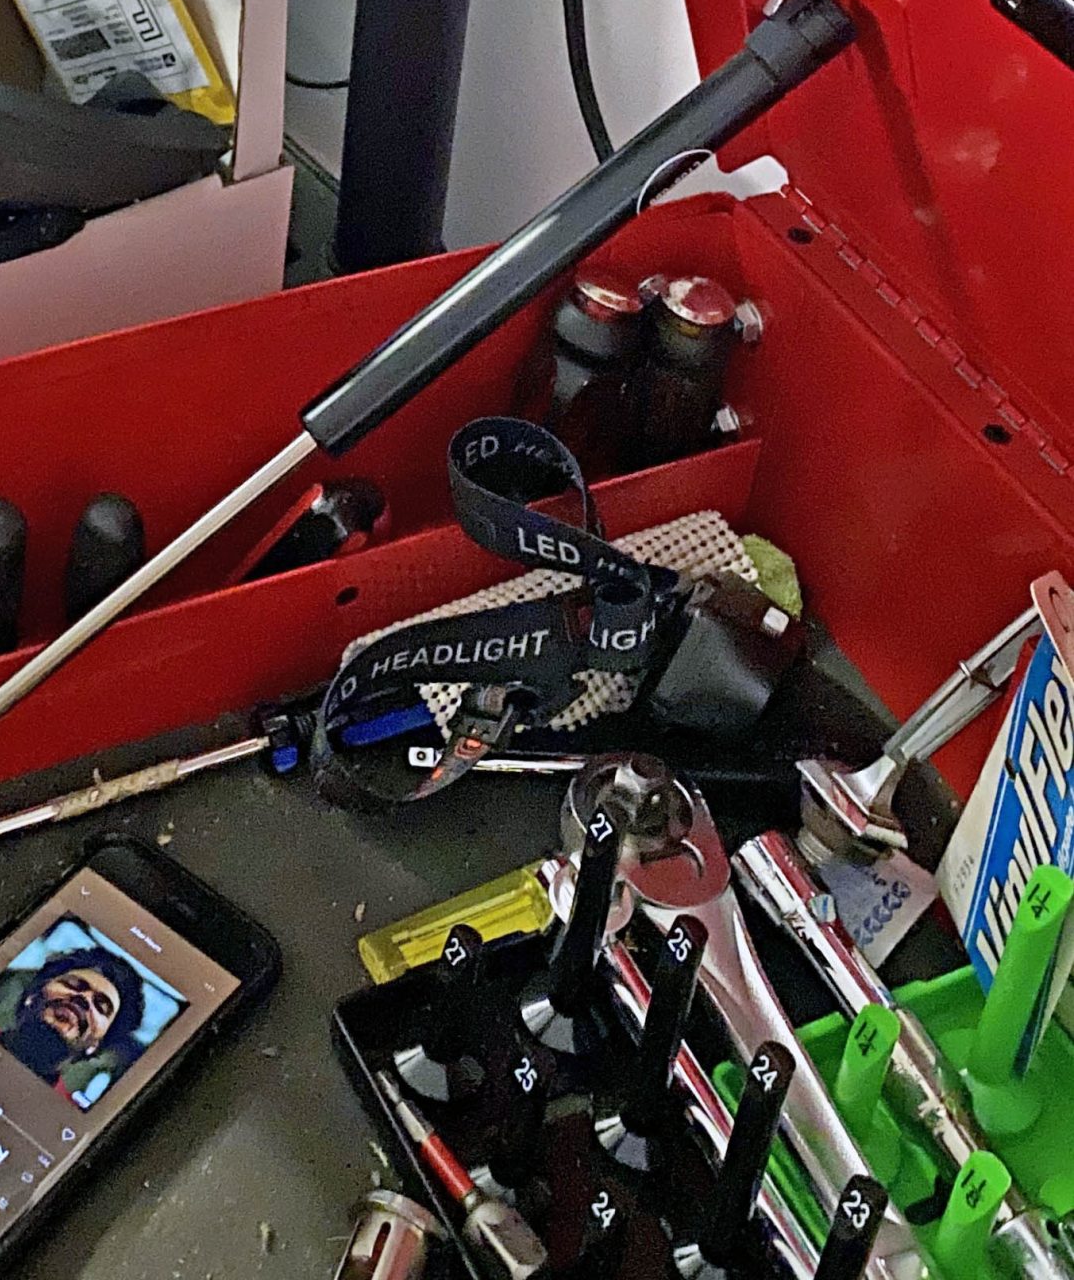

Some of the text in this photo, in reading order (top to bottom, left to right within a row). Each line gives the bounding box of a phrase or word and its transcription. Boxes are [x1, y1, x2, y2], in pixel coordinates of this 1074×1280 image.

[517, 526, 581, 565] LED
[370, 629, 550, 680] HEADLIGHT
[588, 812, 614, 843] 27
[444, 937, 468, 967] 27
[666, 926, 693, 963] 25
[513, 1057, 539, 1093] 25
[750, 1054, 779, 1093] 24
[591, 1191, 617, 1230] 24
[842, 1189, 871, 1229] 23
